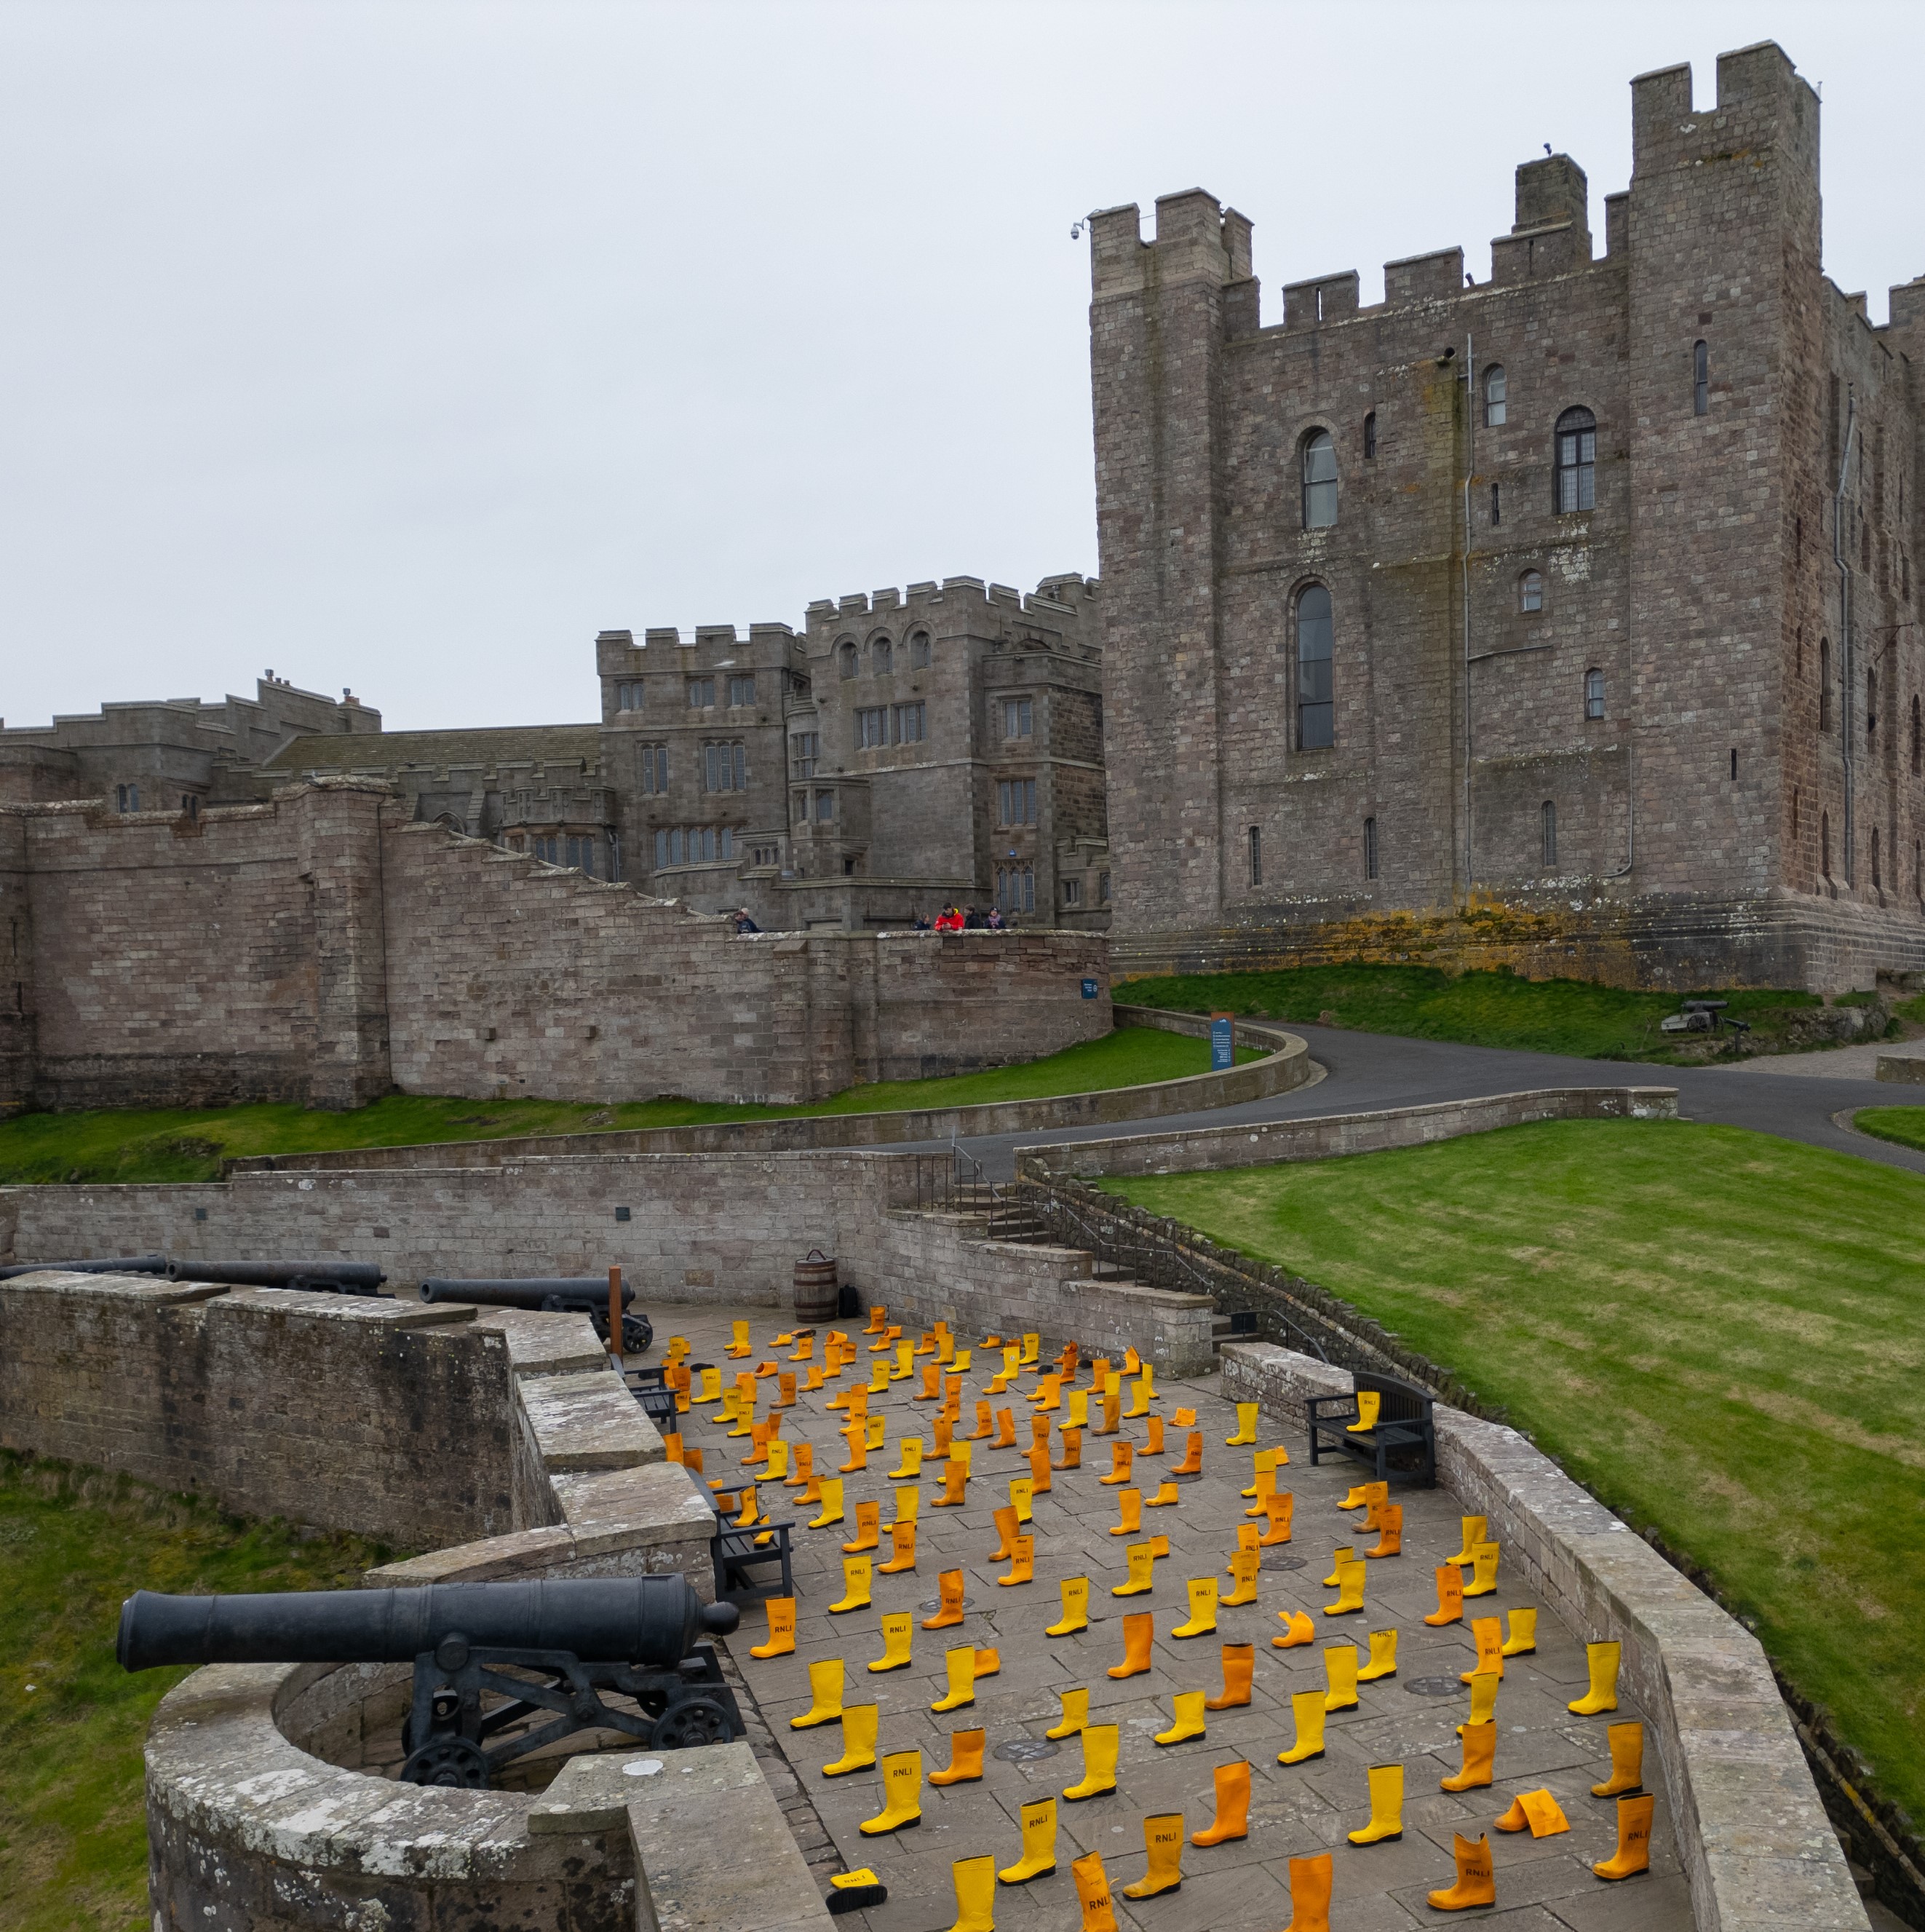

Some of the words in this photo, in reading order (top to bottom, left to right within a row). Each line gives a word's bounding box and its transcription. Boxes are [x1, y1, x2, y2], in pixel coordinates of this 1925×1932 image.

[1242, 1575, 1256, 1583] RNLI
[775, 1625, 791, 1633] RNLI
[890, 1625, 906, 1633] RNLI
[893, 1767, 912, 1778] RNLI
[1029, 1815, 1048, 1828] RNLI
[1156, 1832, 1176, 1843] RNLI
[1628, 1831, 1648, 1841] RNLI
[1466, 1869, 1490, 1877] RNLI
[844, 1875, 866, 1884] RNLI
